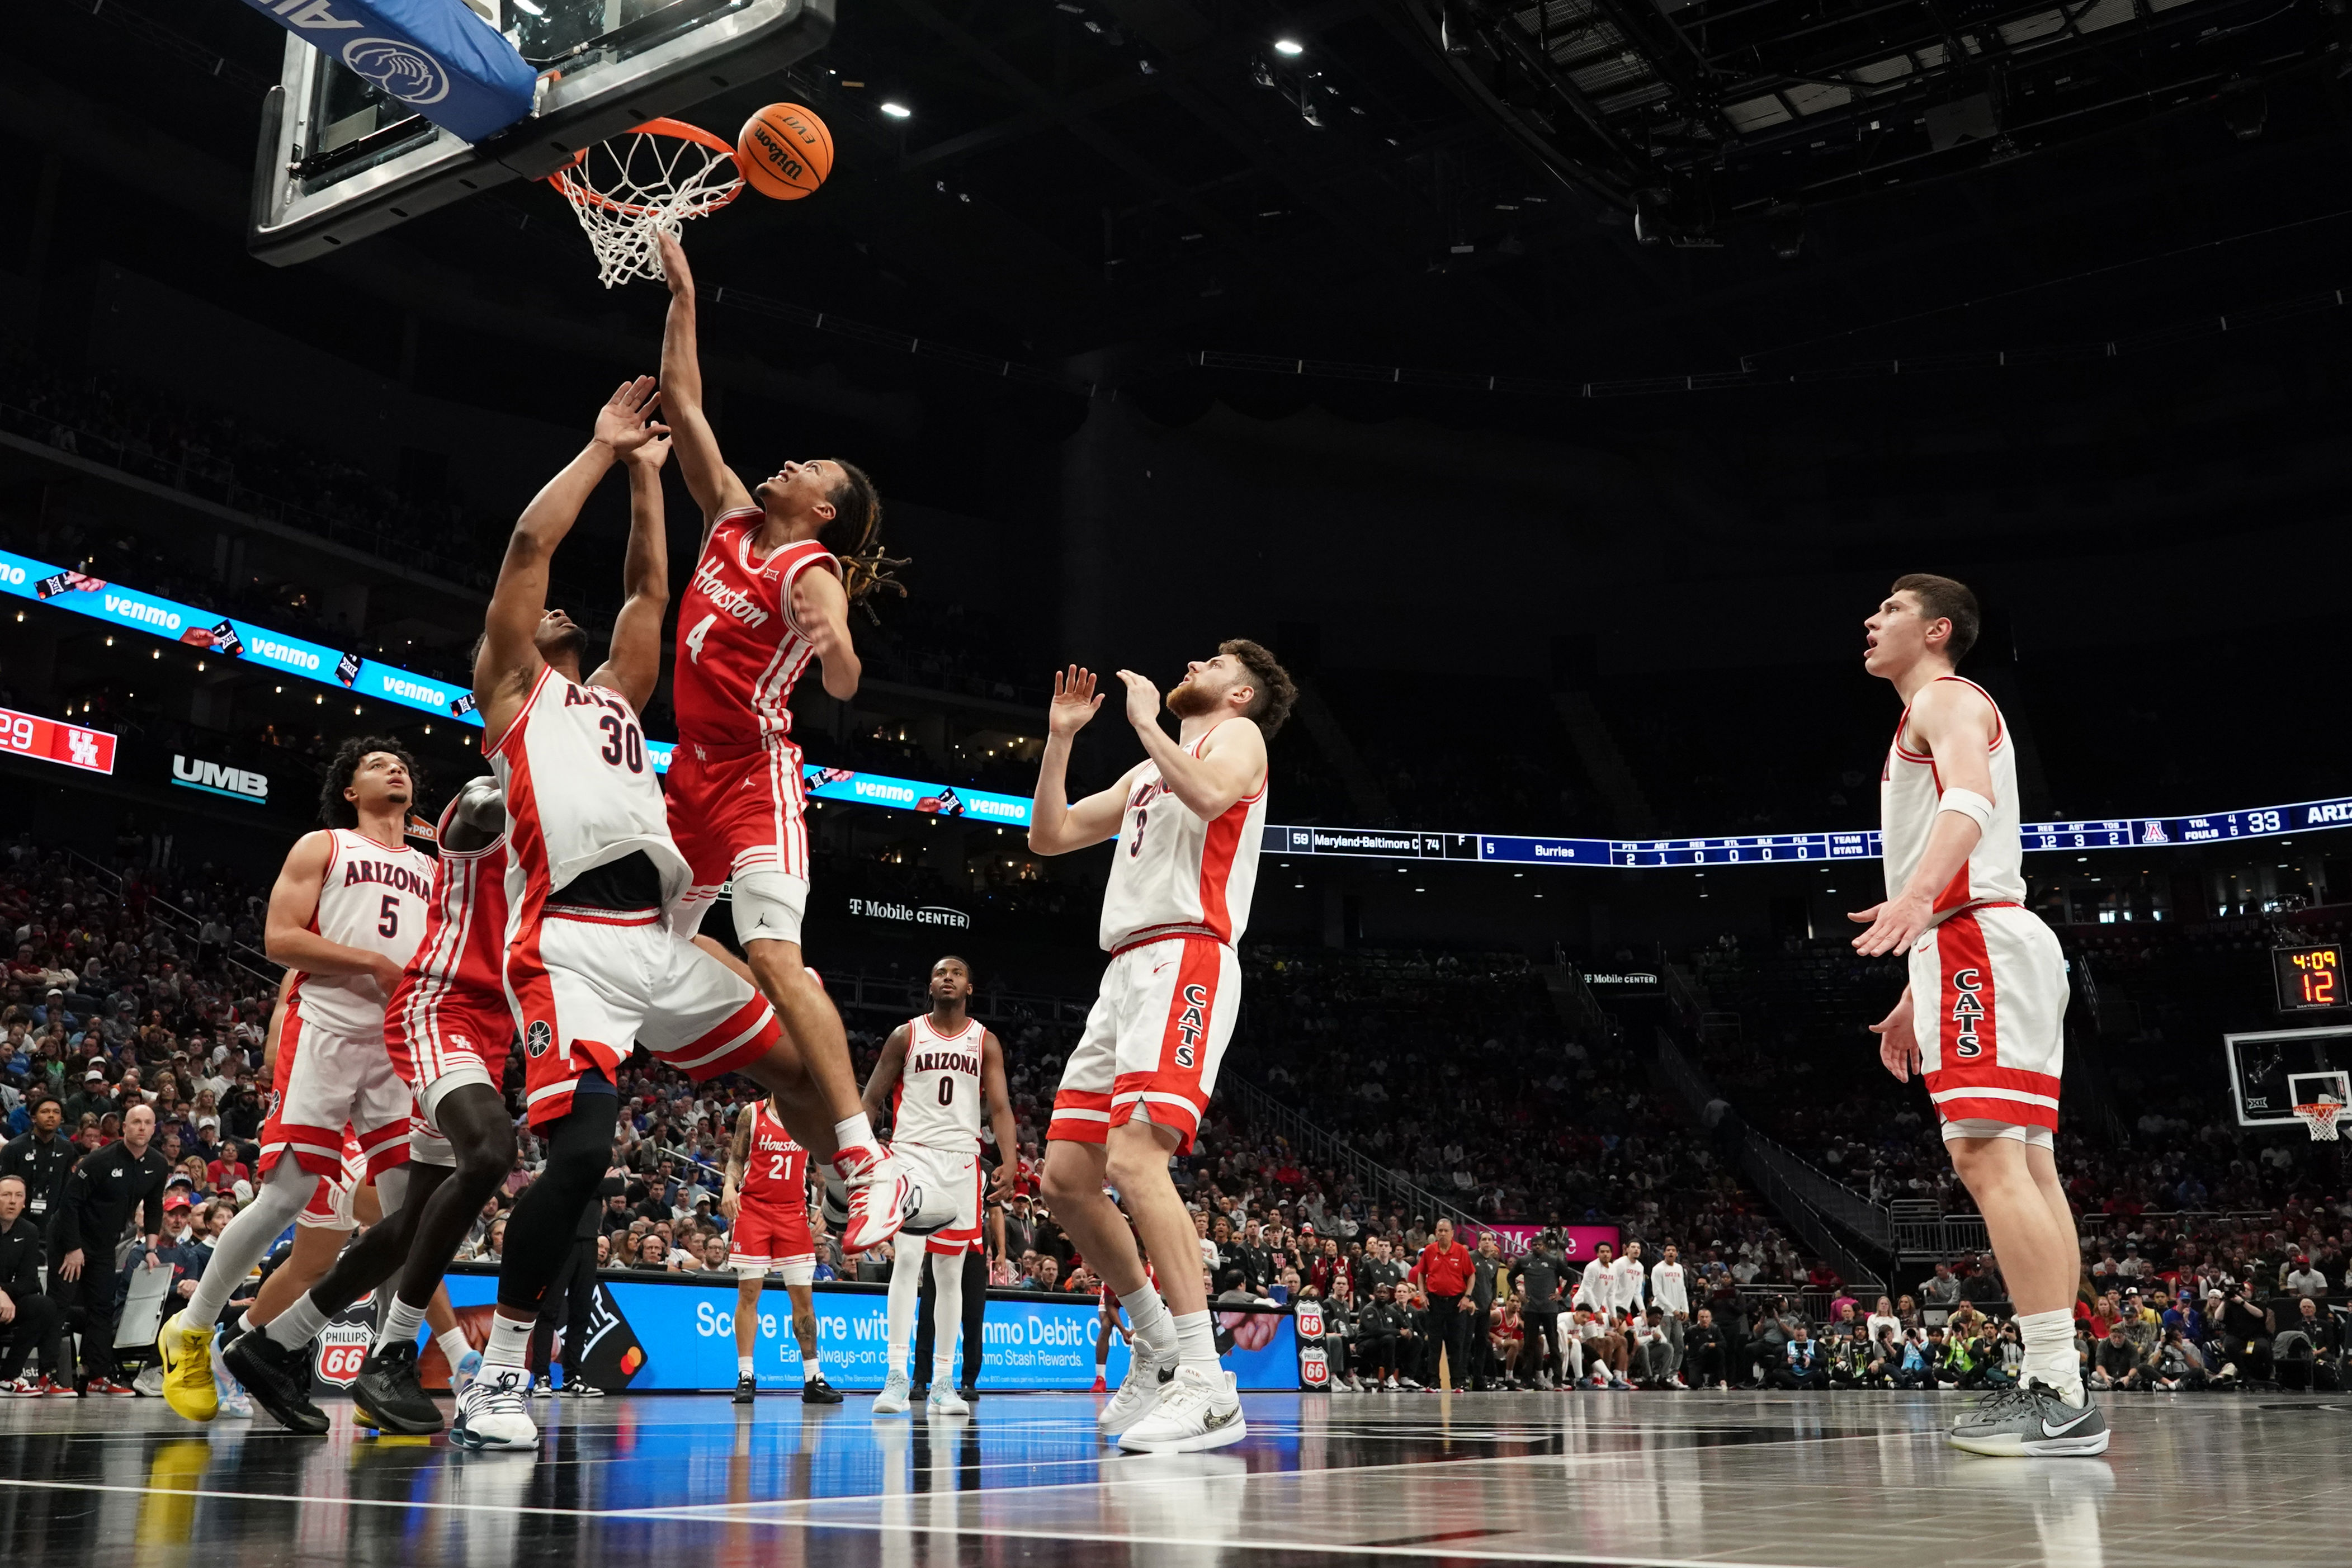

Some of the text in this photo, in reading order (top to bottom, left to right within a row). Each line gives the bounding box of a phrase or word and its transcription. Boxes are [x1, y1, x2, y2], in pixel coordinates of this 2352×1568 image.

[783, 116, 816, 144] EVO
[755, 125, 802, 180] Wilson
[693, 555, 768, 629] Houston
[105, 594, 181, 630] venmo
[686, 613, 717, 665] 4
[252, 637, 320, 670] venmo
[383, 676, 445, 706] venmo
[0, 713, 34, 750] 29
[600, 715, 643, 773] 30
[173, 754, 268, 797] UMB
[856, 781, 914, 802] venmo
[970, 799, 1025, 818] venmo
[2189, 814, 2236, 828] TOL 4
[1131, 809, 1147, 857] 3
[2185, 826, 2238, 840] FOULS 5
[2247, 811, 2280, 833] 33
[1293, 833, 1465, 850] 59 Maryland-Baltimore C 74 F
[1487, 843, 1575, 857] 5 Burries
[1833, 835, 1861, 844] TEAM
[1833, 846, 1863, 855] STATS
[2040, 832, 2119, 848] 12 3 2
[1626, 847, 1807, 865] 2 1 0 0 0 0
[344, 860, 431, 905] ARIZONA
[378, 894, 400, 939] 5
[849, 898, 965, 928] T Mobile CENTER
[2293, 951, 2335, 969] 4:09
[1594, 974, 1622, 984] Mobile
[2304, 971, 2334, 1002] 12
[1953, 968, 1985, 1057] CATS
[1175, 984, 1207, 1069] CATS
[915, 1052, 978, 1077] ARIZONA
[938, 1076, 953, 1106] 0
[769, 1154, 792, 1180] 21
[696, 1301, 777, 1338] Sce
[853, 1309, 889, 1340] wit
[1028, 1316, 1082, 1346] Debit
[1302, 1319, 1318, 1332] 66
[326, 1332, 367, 1343] PHILLIPS
[327, 1348, 363, 1373] 66
[781, 1344, 802, 1363] Ear
[1005, 1350, 1037, 1366] Stash
[1038, 1350, 1084, 1367] Rewards.
[21, 1367, 39, 1377] lsta
[1306, 1363, 1323, 1378] 66
